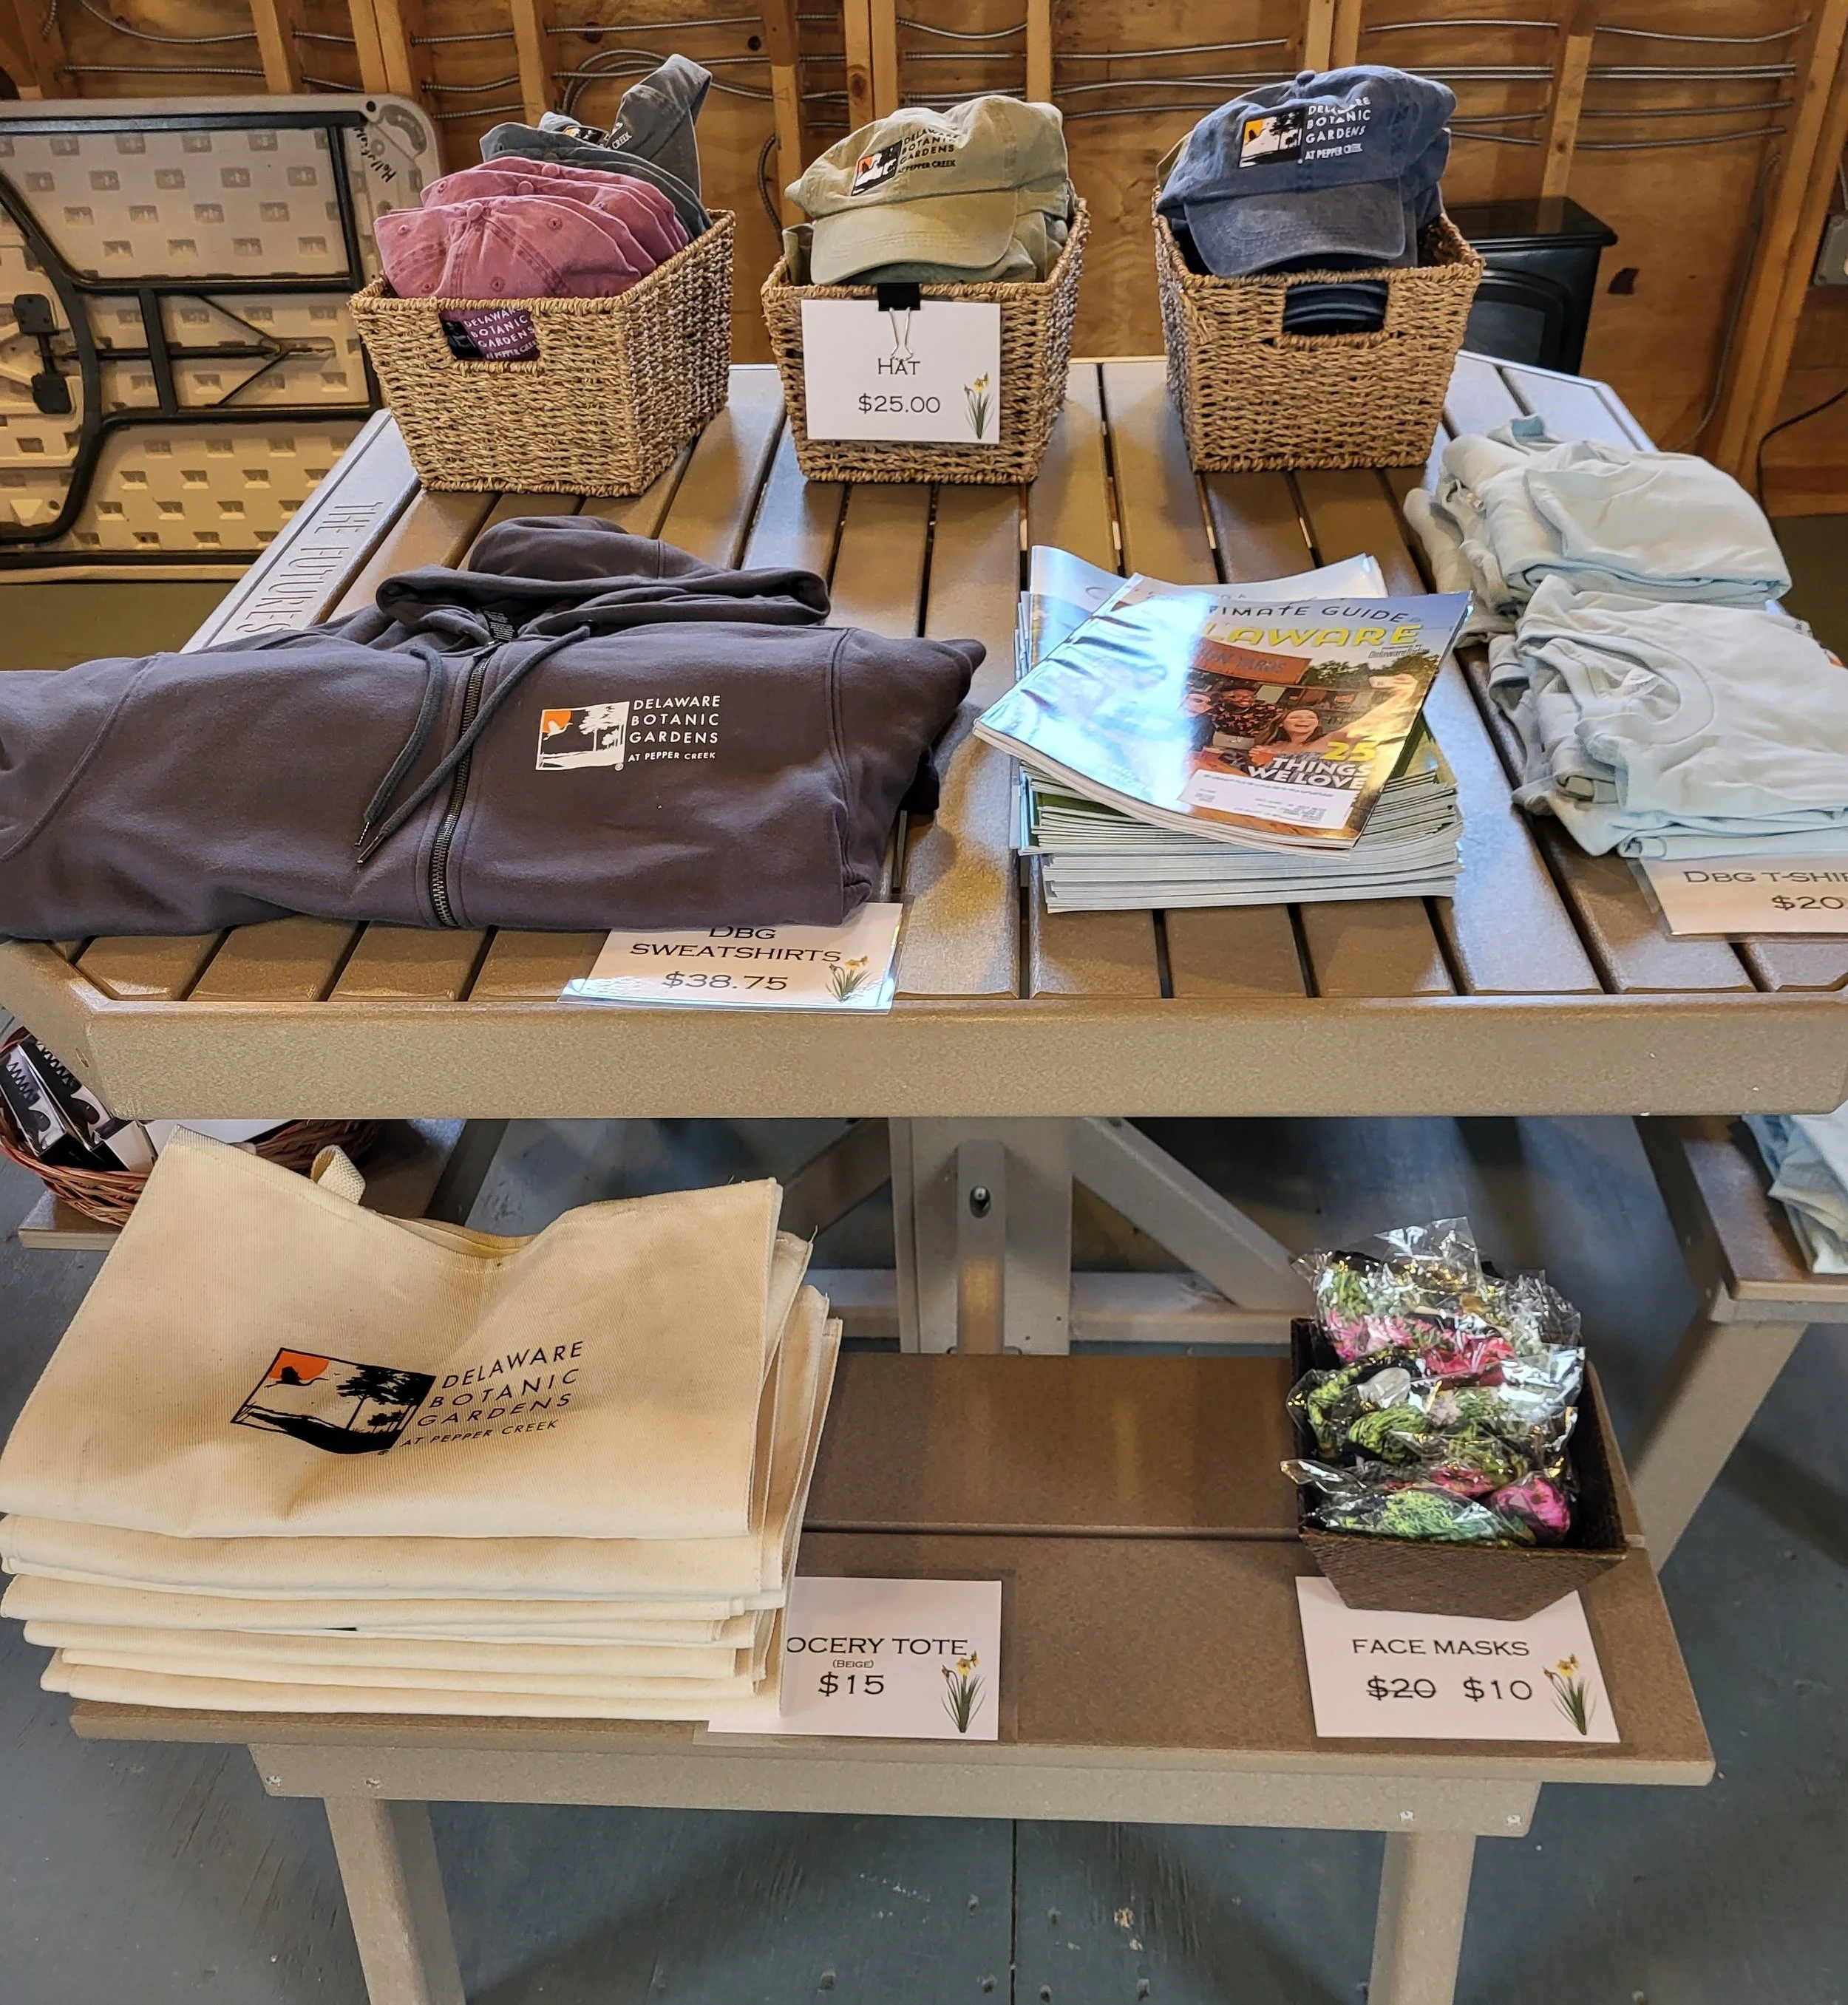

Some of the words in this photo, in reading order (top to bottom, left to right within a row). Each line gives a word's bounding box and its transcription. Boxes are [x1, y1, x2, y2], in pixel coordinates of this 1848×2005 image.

[1306, 110, 1371, 129] BOTANIC
[1305, 125, 1366, 144] GARDENS
[900, 144, 955, 164] GARDENS
[1305, 151, 1315, 160] AT
[1317, 148, 1343, 160] PEPPER
[906, 162, 930, 171] PEPPER
[931, 159, 956, 168] CREEK
[463, 306, 523, 327] DELAWAR
[470, 314, 528, 338] BOTANIC
[478, 326, 535, 349] GARDENS
[877, 357, 921, 375] HAT
[858, 392, 940, 414] $25.00
[315, 502, 384, 534] THE
[236, 547, 350, 633] FUTURES
[1209, 605, 1311, 617] TIMATE
[1321, 605, 1410, 623] GUIDE
[1203, 622, 1423, 647] LAWARE
[633, 695, 721, 710] DELAWARE
[631, 713, 719, 726] BOTANIC
[629, 730, 719, 744] GARDENS
[628, 753, 641, 763] AT
[645, 750, 680, 760] PEPPER
[684, 752, 716, 760] CREEK
[1321, 741, 1376, 762] 25
[1271, 757, 1374, 777] THINGS
[1248, 765, 1292, 783] WE
[1299, 775, 1368, 791] LOVE
[1683, 871, 1756, 883] DBG
[709, 926, 777, 940] DBG
[630, 943, 842, 962] SWEATSHIRTS
[662, 970, 788, 991] $38.75
[441, 1341, 583, 1389] DELAWARE
[429, 1368, 579, 1409] BOTANIC
[417, 1392, 571, 1427] GARDENS
[400, 1437, 426, 1448] AT
[430, 1429, 493, 1444] PEPPER
[501, 1418, 559, 1435] CREEK
[787, 1636, 885, 1654] OCERY
[891, 1638, 968, 1656] TOTE
[1352, 1638, 1427, 1655] FACE
[1433, 1639, 1529, 1657] MASKS
[818, 1671, 885, 1698] $15
[1367, 1675, 1436, 1701] $20
[1463, 1676, 1532, 1702] $10
